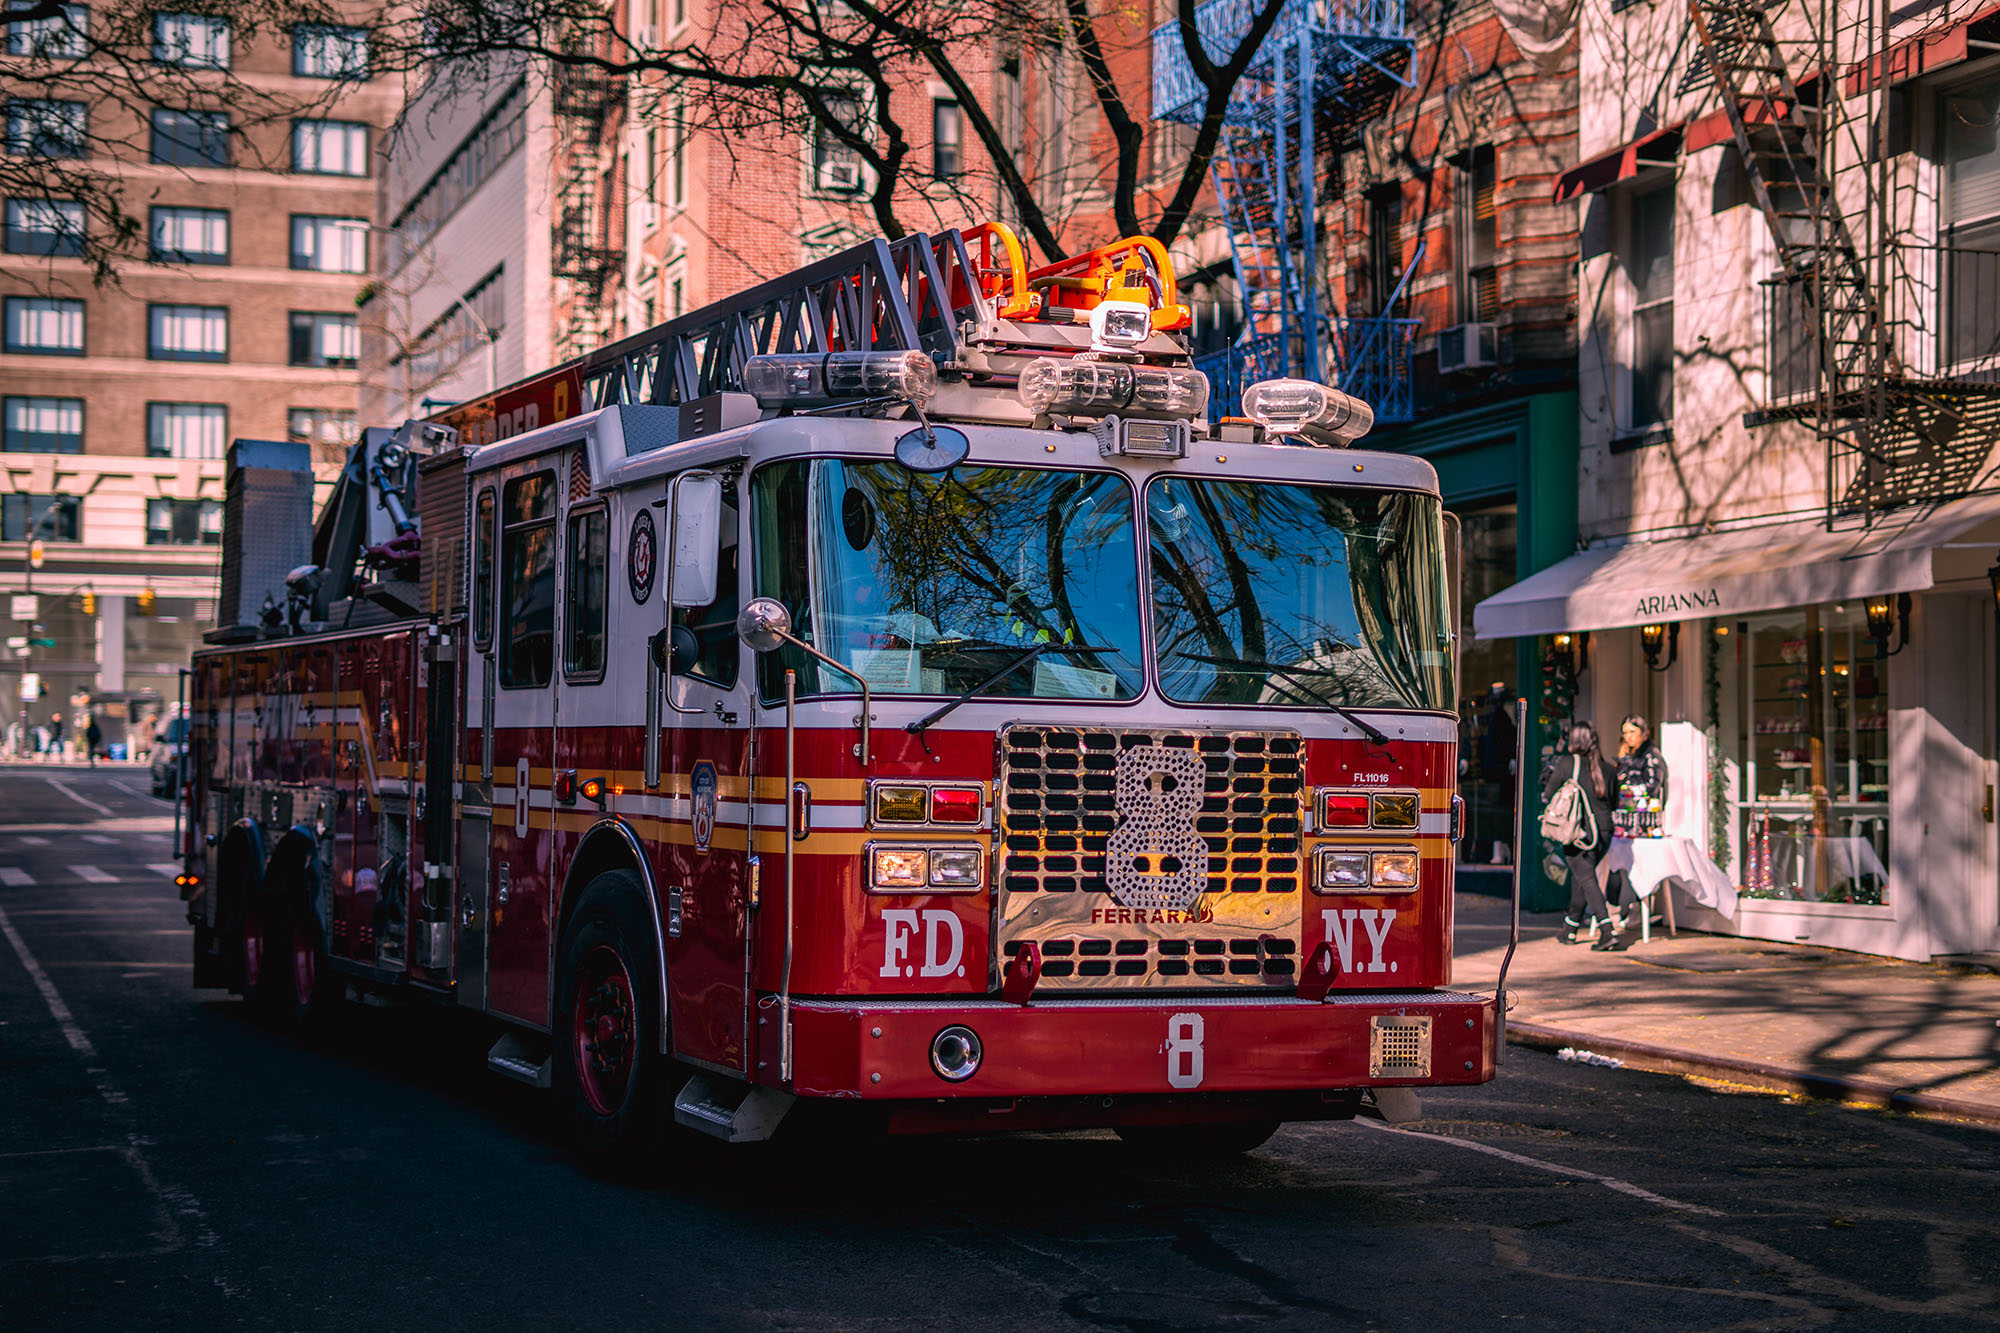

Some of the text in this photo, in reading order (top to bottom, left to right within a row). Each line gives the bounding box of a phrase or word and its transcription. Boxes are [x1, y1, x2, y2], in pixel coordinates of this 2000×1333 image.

[1634, 588, 1720, 616] ARIANNA
[515, 757, 530, 839] 8
[1353, 772, 1389, 783] FL11016
[1106, 744, 1209, 910] 8
[880, 909, 965, 978] F.D.
[1091, 908, 1197, 924] FERRARA
[1167, 1012, 1205, 1089] 8
